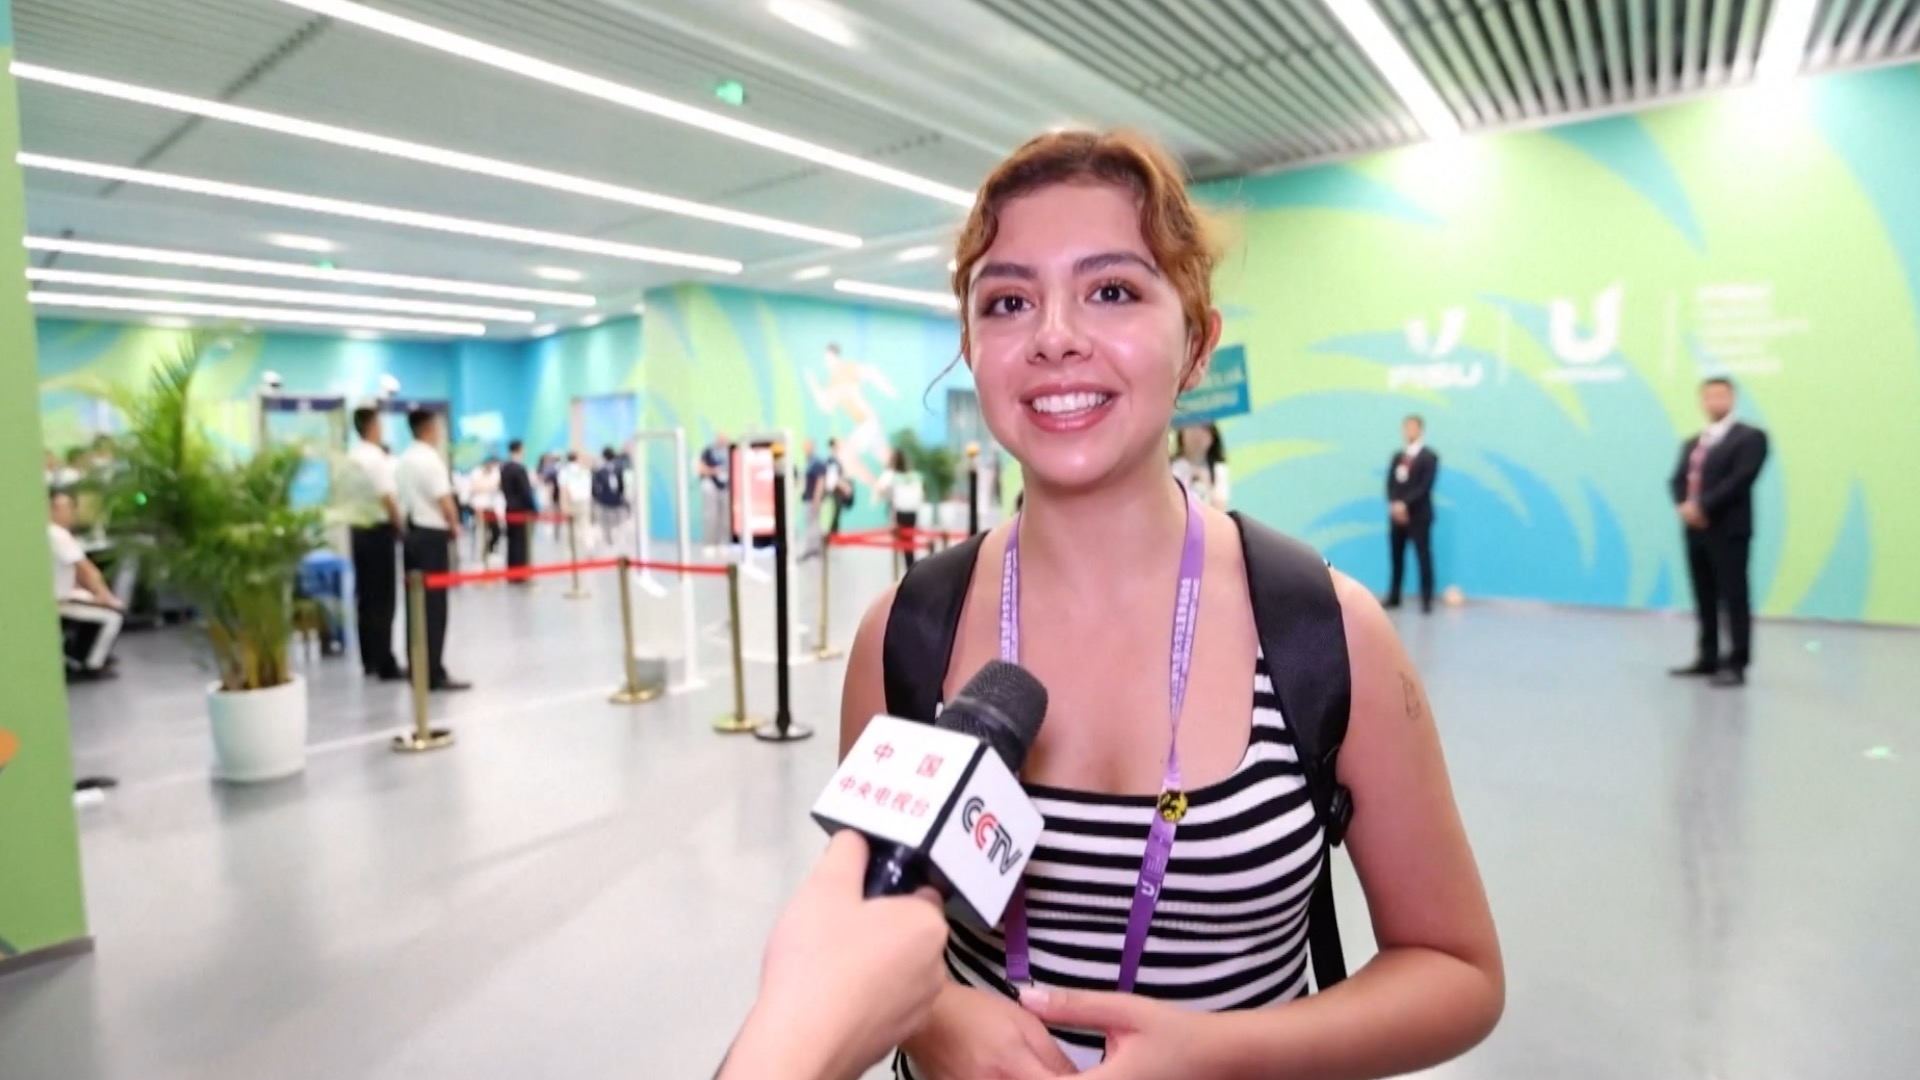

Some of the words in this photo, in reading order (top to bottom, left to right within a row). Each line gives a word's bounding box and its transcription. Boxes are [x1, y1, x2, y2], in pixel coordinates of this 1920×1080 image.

[839, 776, 930, 818] 中央电视台
[962, 796, 1022, 875] CCTV
